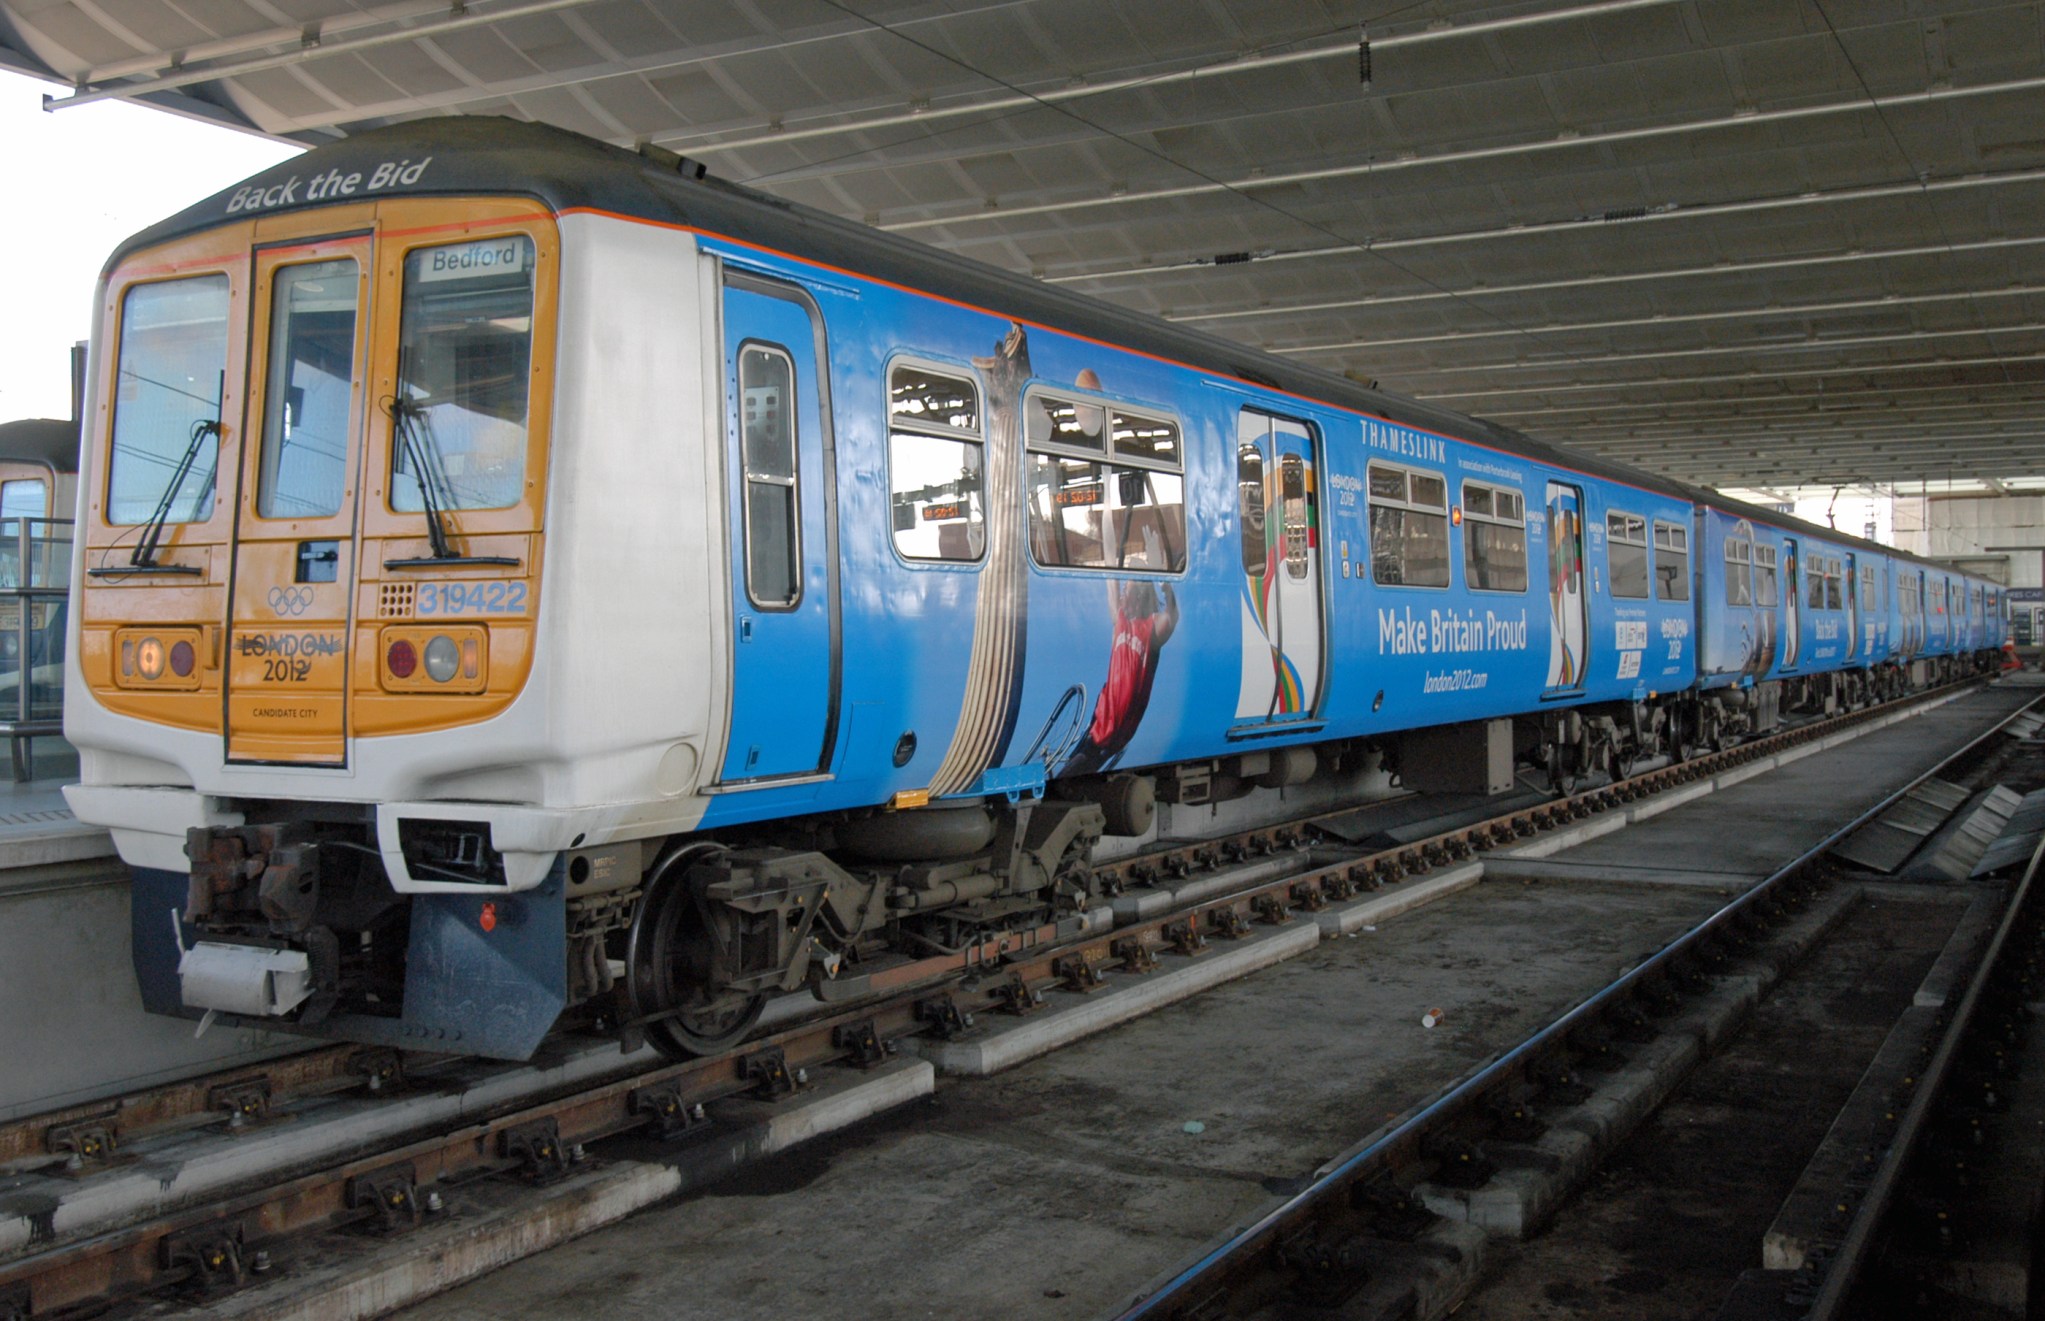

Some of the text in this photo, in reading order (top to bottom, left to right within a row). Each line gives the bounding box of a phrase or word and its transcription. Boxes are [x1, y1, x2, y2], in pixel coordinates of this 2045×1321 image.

[226, 156, 433, 213] Back the Bid
[433, 242, 515, 271] Bedford
[1360, 419, 1446, 464] THAMESLINK
[418, 582, 528, 614] 319422
[240, 633, 336, 657] LONDON
[1378, 606, 1527, 655] Make Britain Proud
[263, 659, 312, 682] 2012
[1423, 669, 1489, 694] london2012.com
[253, 708, 318, 719] CANDIDATE CITY
